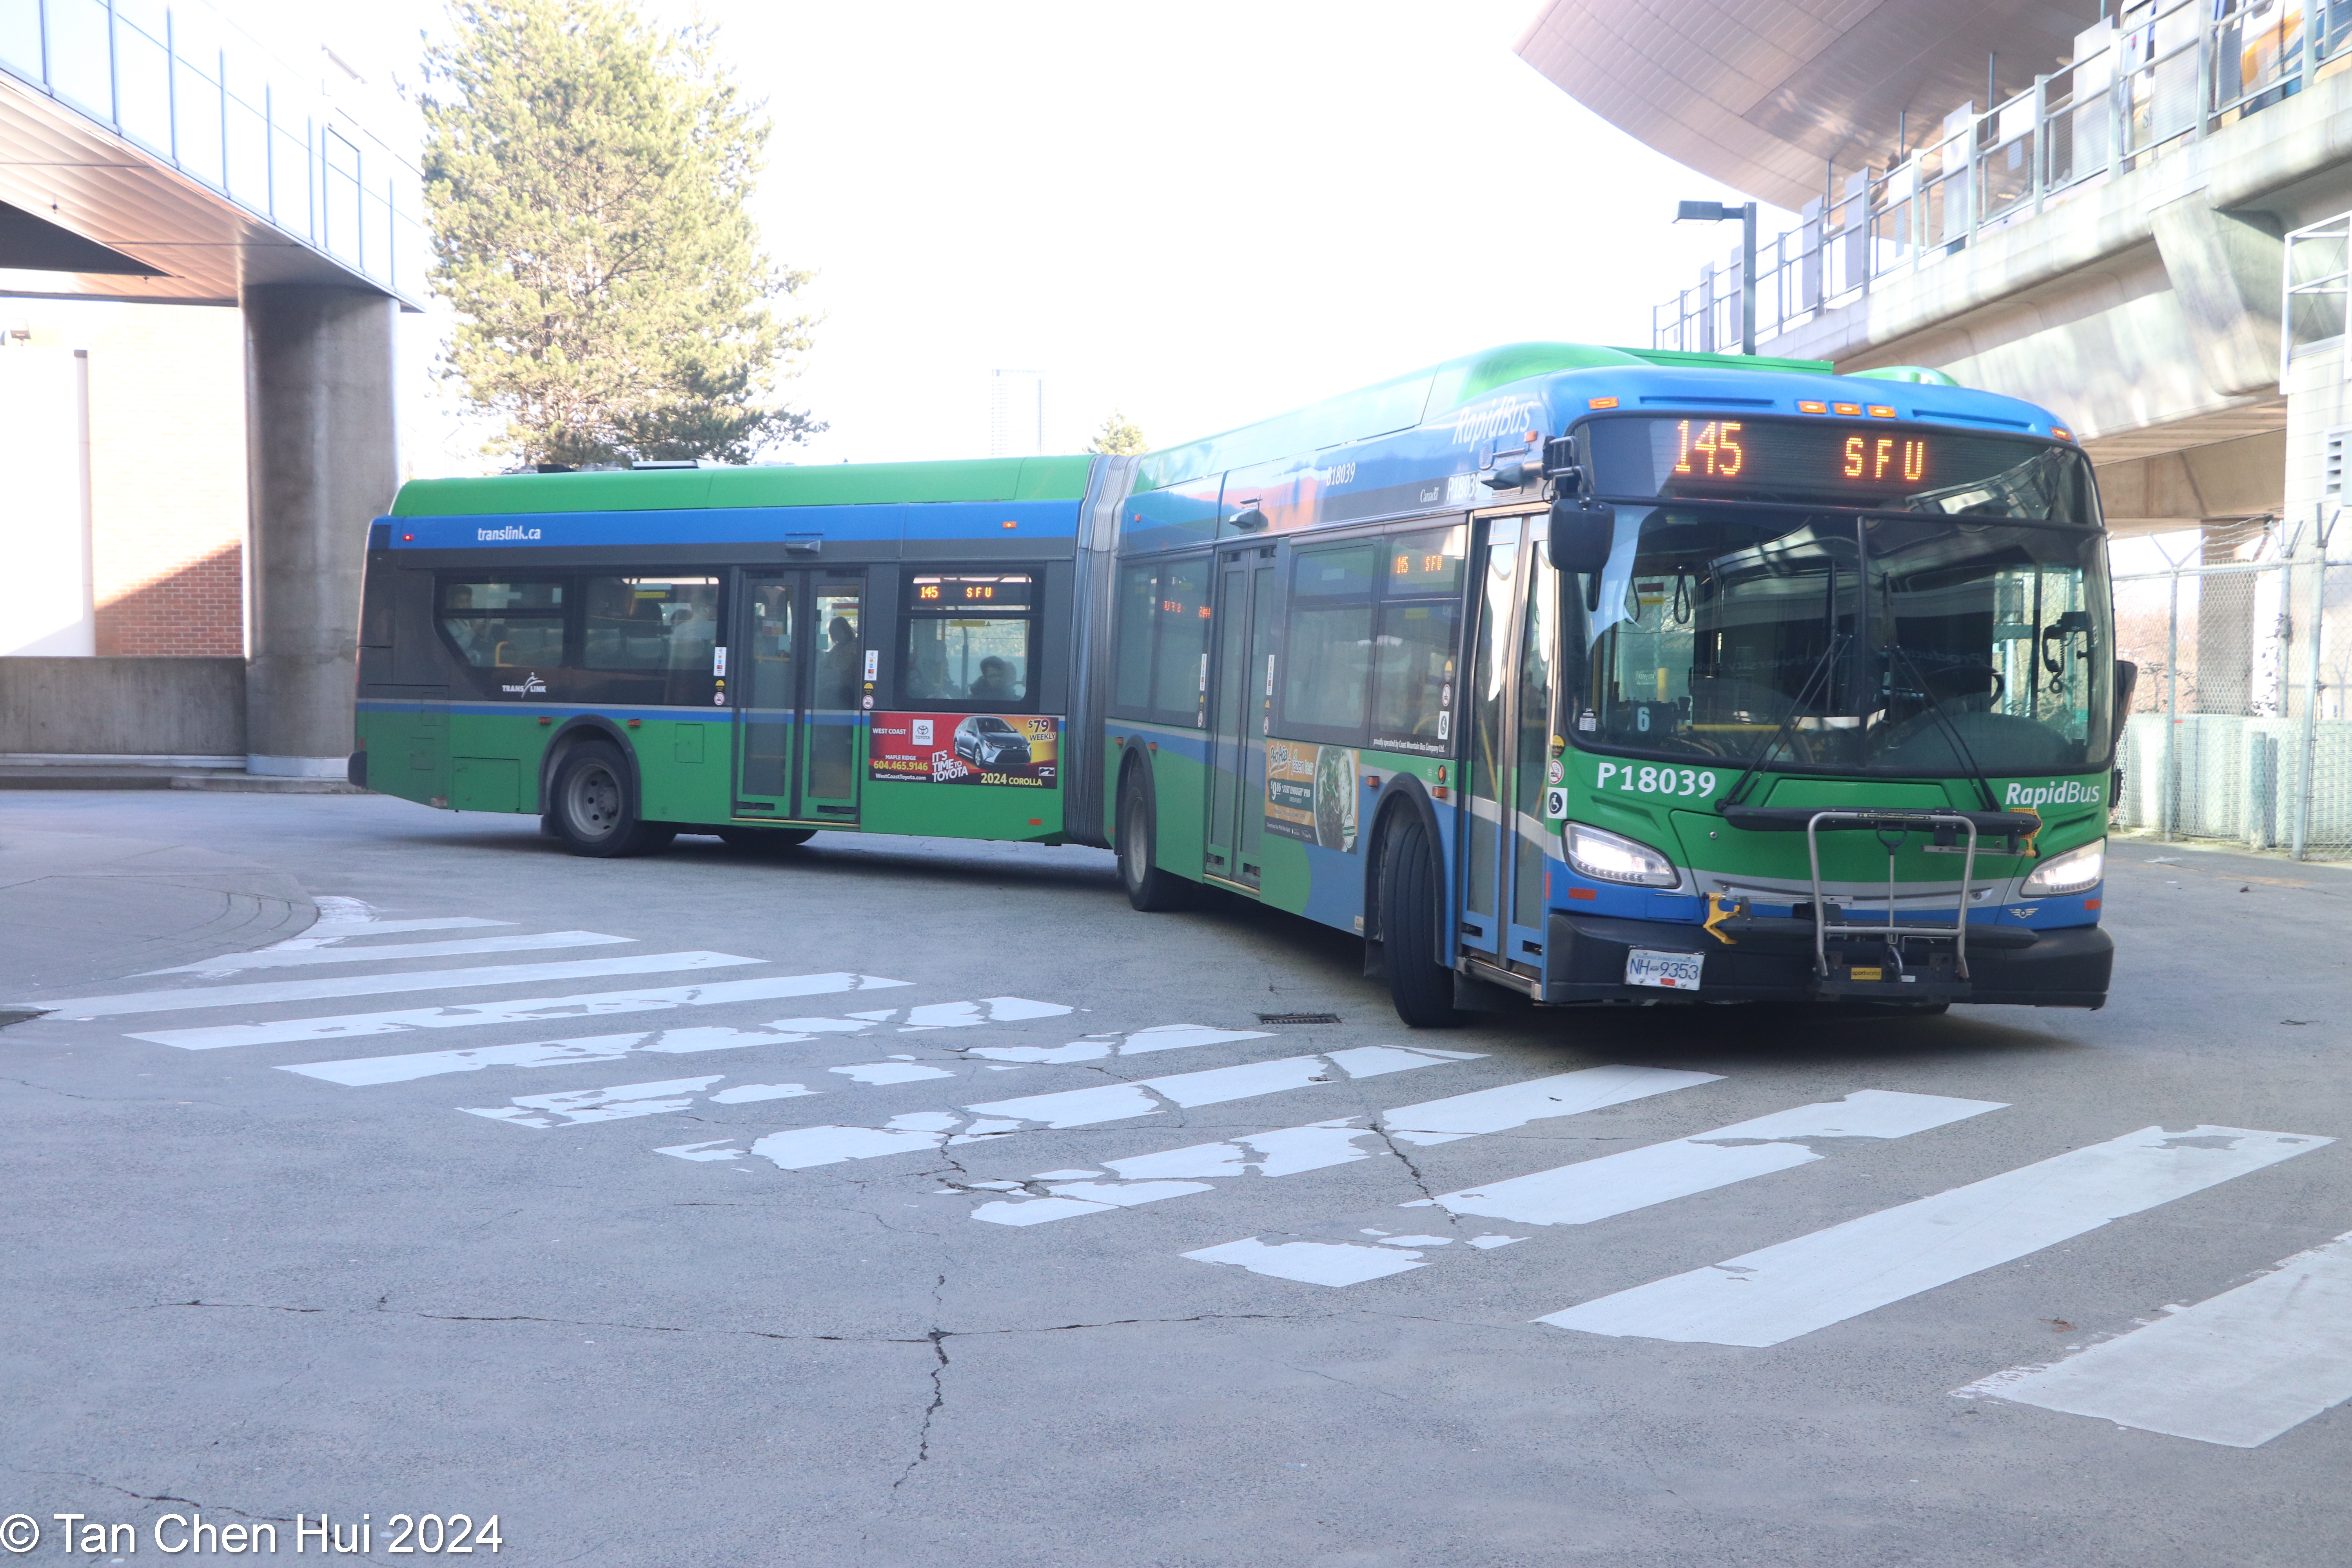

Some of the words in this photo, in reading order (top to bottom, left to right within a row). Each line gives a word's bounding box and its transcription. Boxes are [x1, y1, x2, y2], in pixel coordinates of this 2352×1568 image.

[1452, 396, 1533, 452] RapidBus
[1676, 419, 1742, 475] 145
[1326, 462, 1356, 487] B18039
[1446, 472, 1481, 500] P18039
[1420, 488, 1438, 503] Canada
[477, 525, 541, 541] translink.ca
[921, 586, 938, 598] 145
[1028, 719, 1049, 733] $79
[1637, 706, 1650, 732] 6
[1029, 732, 1056, 740] WEEKLY
[932, 750, 947, 763] IT'S
[873, 760, 928, 771] 604.465.9146
[932, 759, 954, 772] TIME
[932, 766, 968, 782] TOYOTA
[981, 772, 1007, 784] 2024
[1009, 777, 1043, 786] COROLLA
[1597, 762, 1716, 797] P18039
[2005, 780, 2100, 809] RapidBus
[1630, 958, 1650, 975] NH
[1660, 962, 1699, 980] 9353
